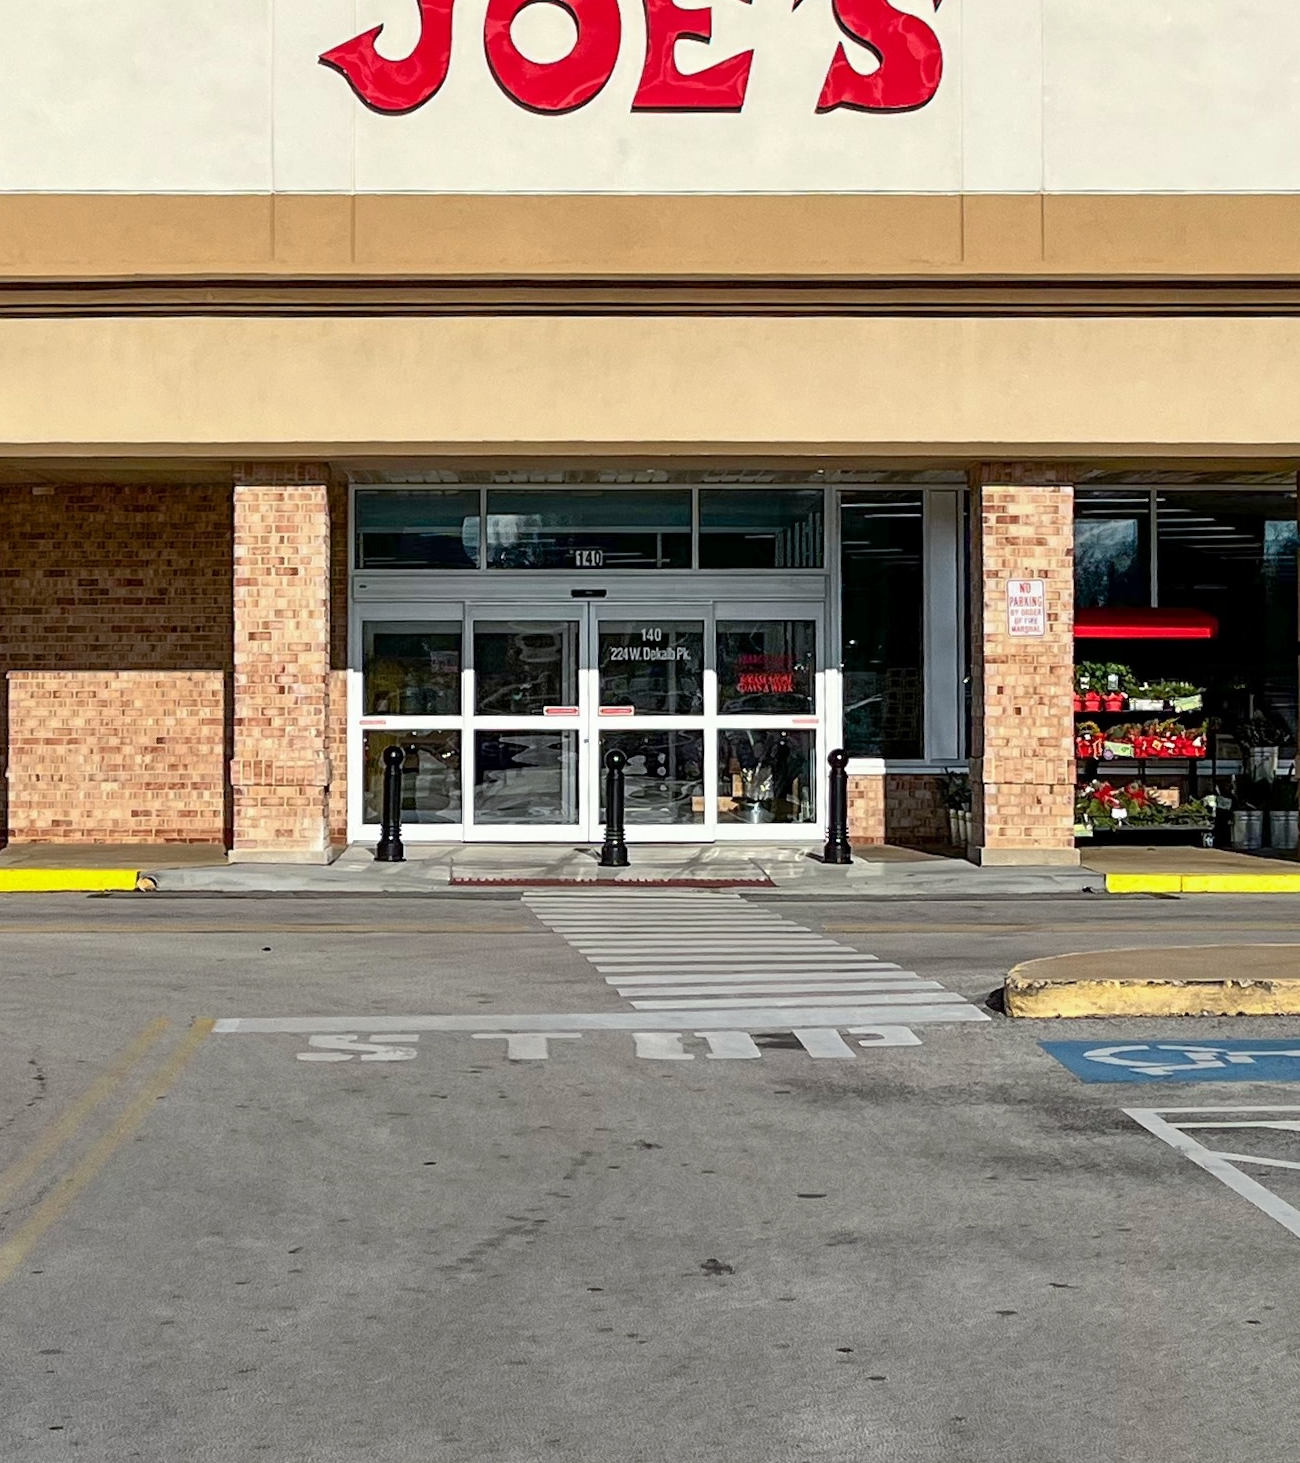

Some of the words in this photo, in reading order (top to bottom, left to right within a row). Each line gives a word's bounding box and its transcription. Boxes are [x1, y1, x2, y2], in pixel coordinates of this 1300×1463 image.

[575, 549, 603, 567] 140
[1019, 582, 1031, 594] NO
[1009, 596, 1043, 607] PARKING
[641, 628, 662, 641] 140
[610, 647, 628, 660] 224
[297, 1025, 923, 1062] STOP
